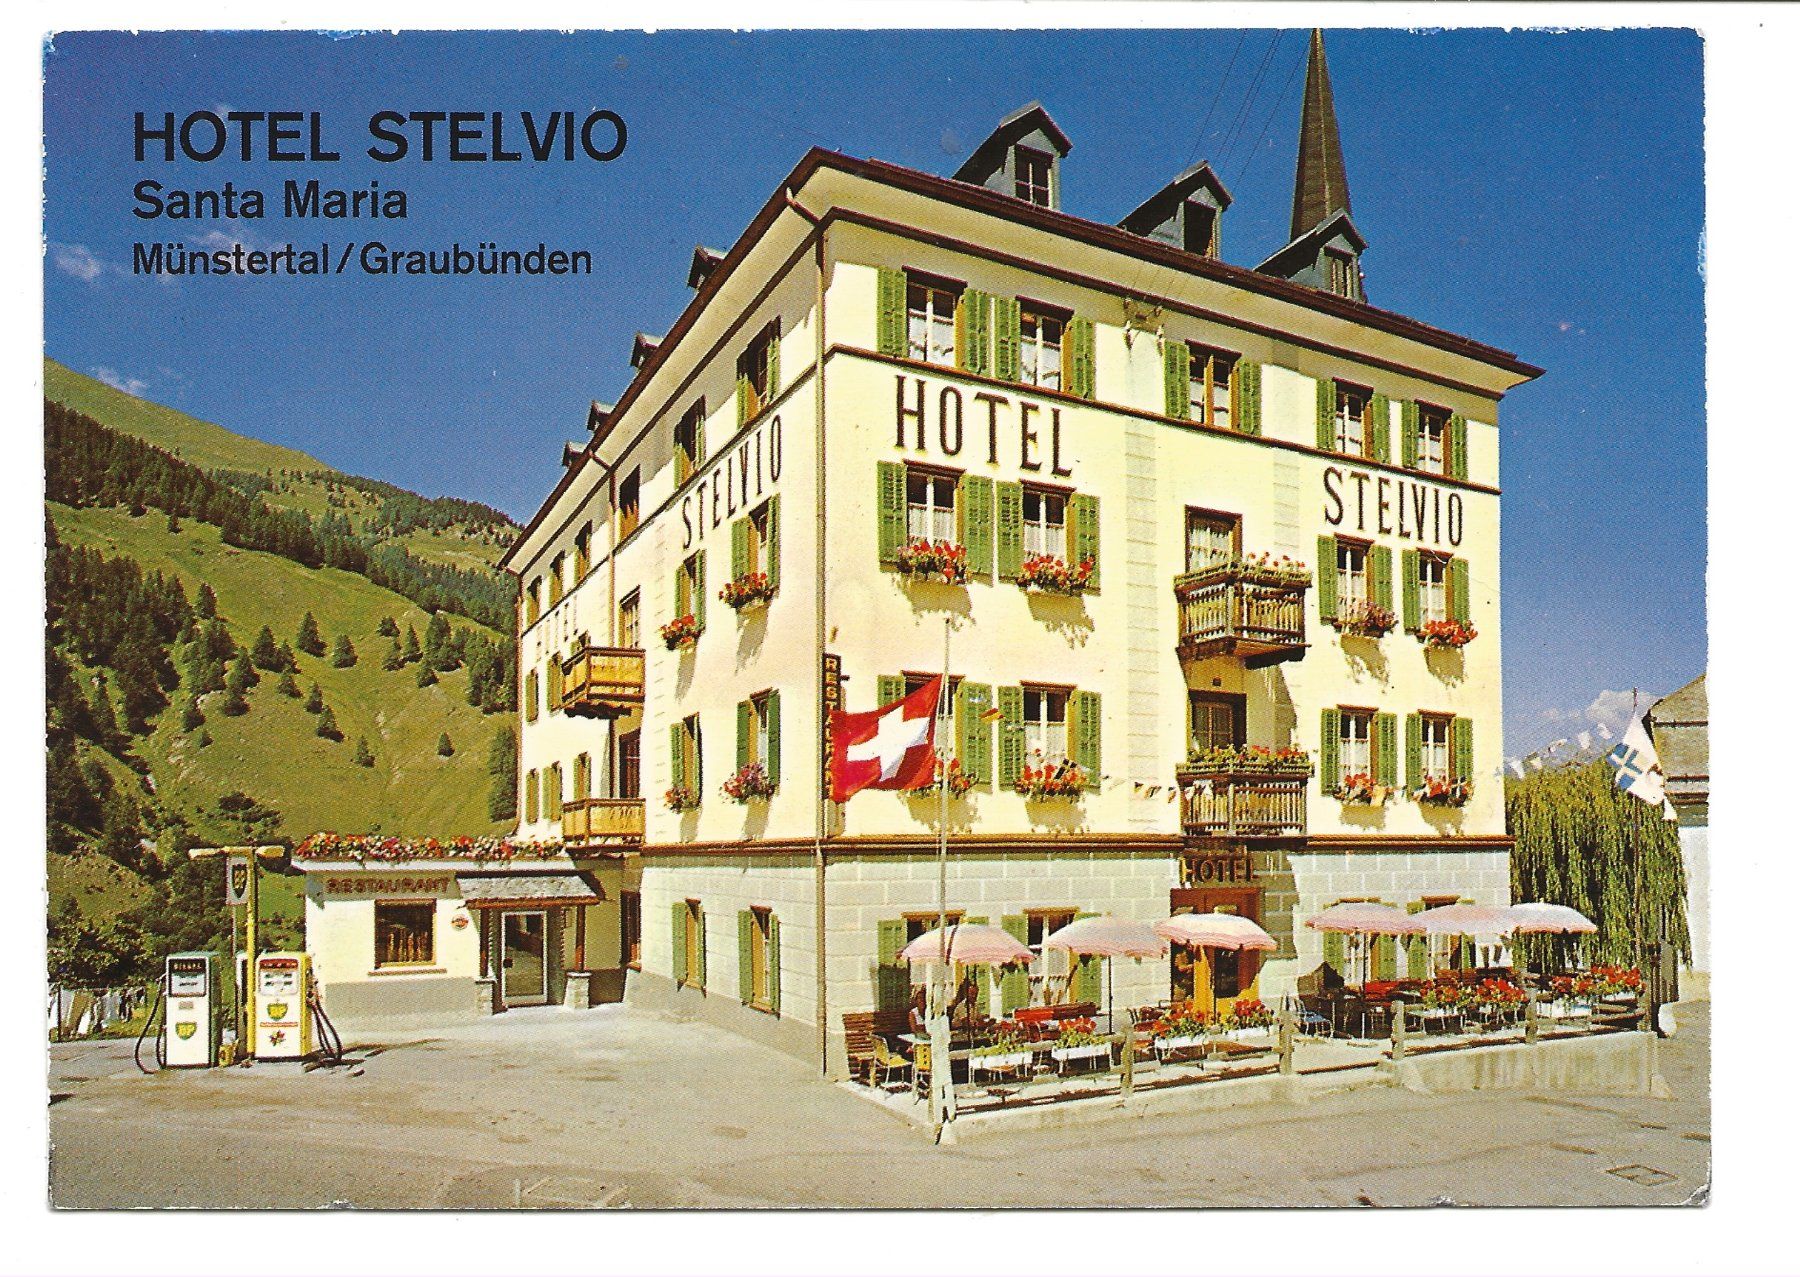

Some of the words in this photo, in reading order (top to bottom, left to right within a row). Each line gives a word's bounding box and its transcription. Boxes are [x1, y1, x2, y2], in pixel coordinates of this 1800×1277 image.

[893, 374, 1073, 478] HOTEL
[681, 414, 782, 549] STELVIO
[1323, 465, 1464, 547] STELVIO
[326, 876, 450, 894] RESTAURANT
[1179, 855, 1260, 885] HOTEL
